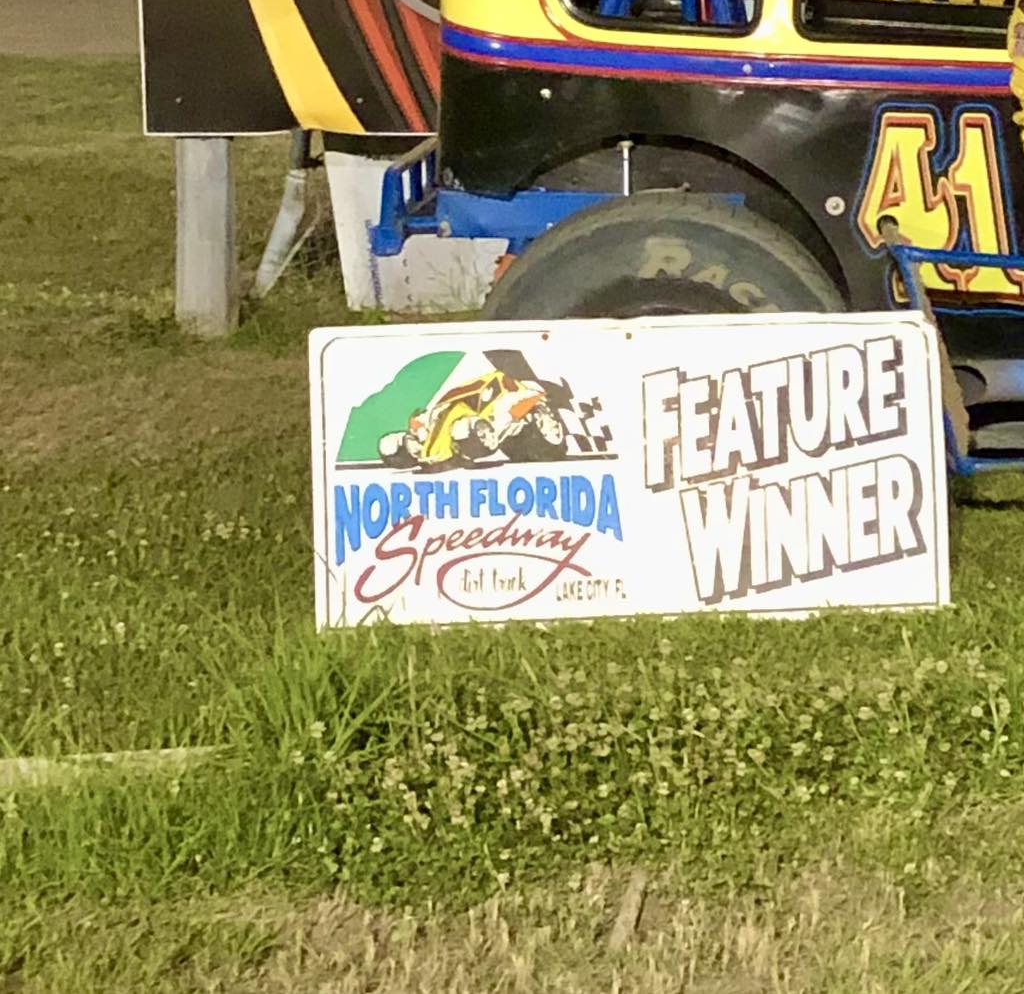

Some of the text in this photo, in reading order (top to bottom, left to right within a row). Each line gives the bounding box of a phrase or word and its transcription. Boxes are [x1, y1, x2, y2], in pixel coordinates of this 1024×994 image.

[643, 336, 908, 494] FEATURE
[335, 473, 625, 565] NORTH FLORIDA
[354, 513, 592, 610] Speedway
[680, 453, 927, 605] WINNER
[556, 579, 583, 602] LAKE
[586, 577, 609, 600] CITY
